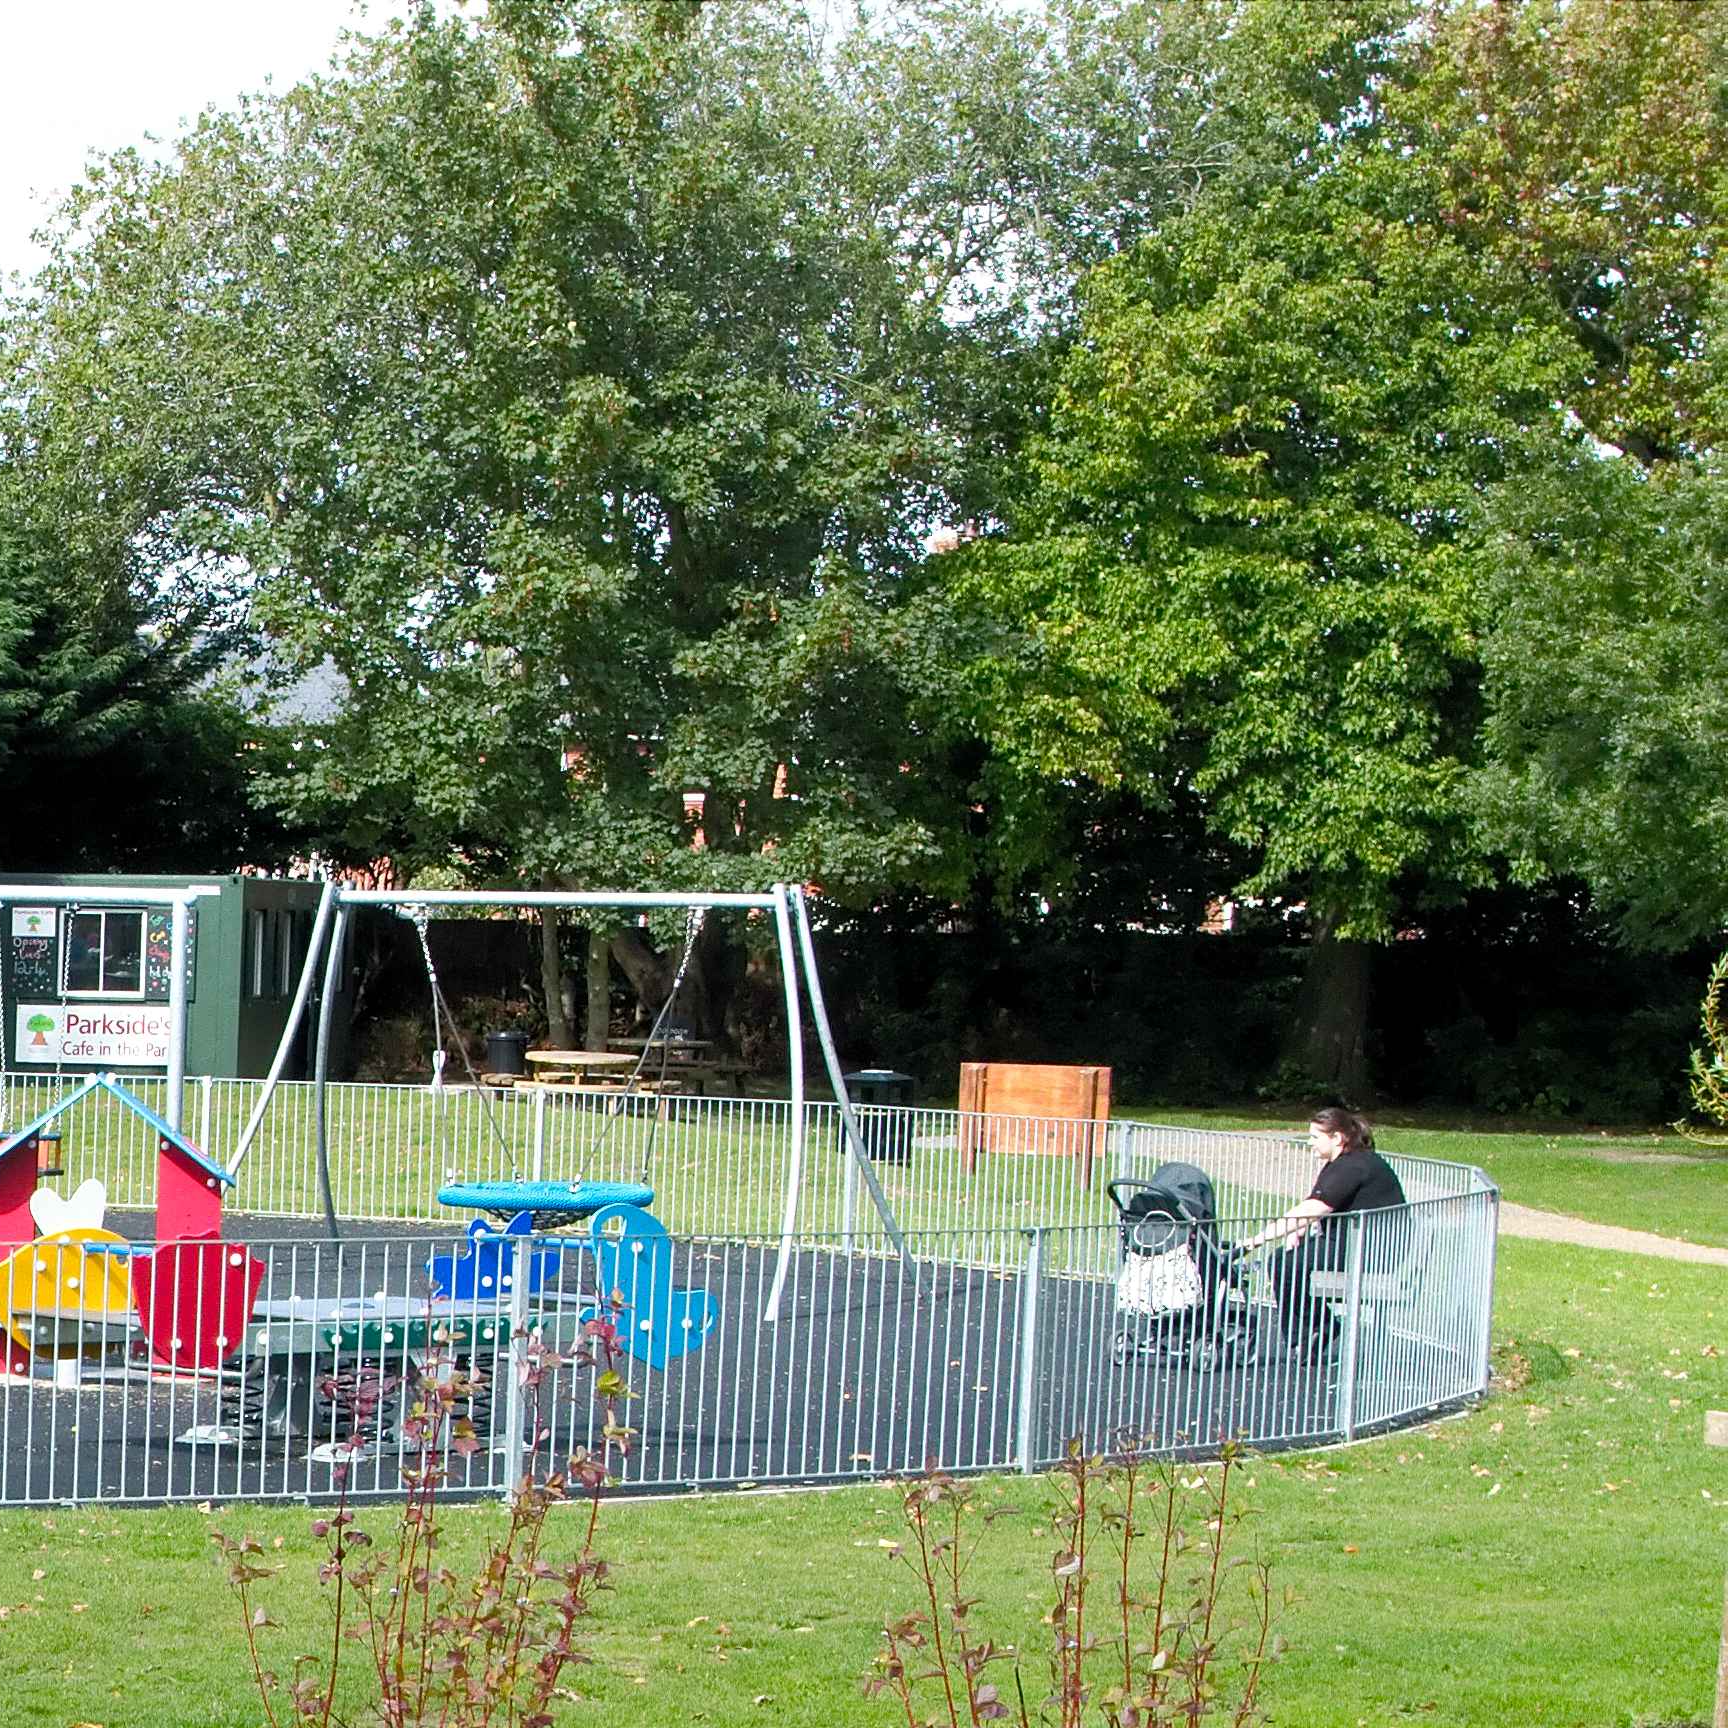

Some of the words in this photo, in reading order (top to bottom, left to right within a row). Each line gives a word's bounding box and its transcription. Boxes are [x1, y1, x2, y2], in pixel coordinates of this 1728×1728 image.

[66, 1013, 173, 1036] Parkside's
[62, 1040, 95, 1056] Cafe
[99, 1041, 111, 1056] in
[117, 1041, 141, 1056] the
[146, 1042, 168, 1057] Par
